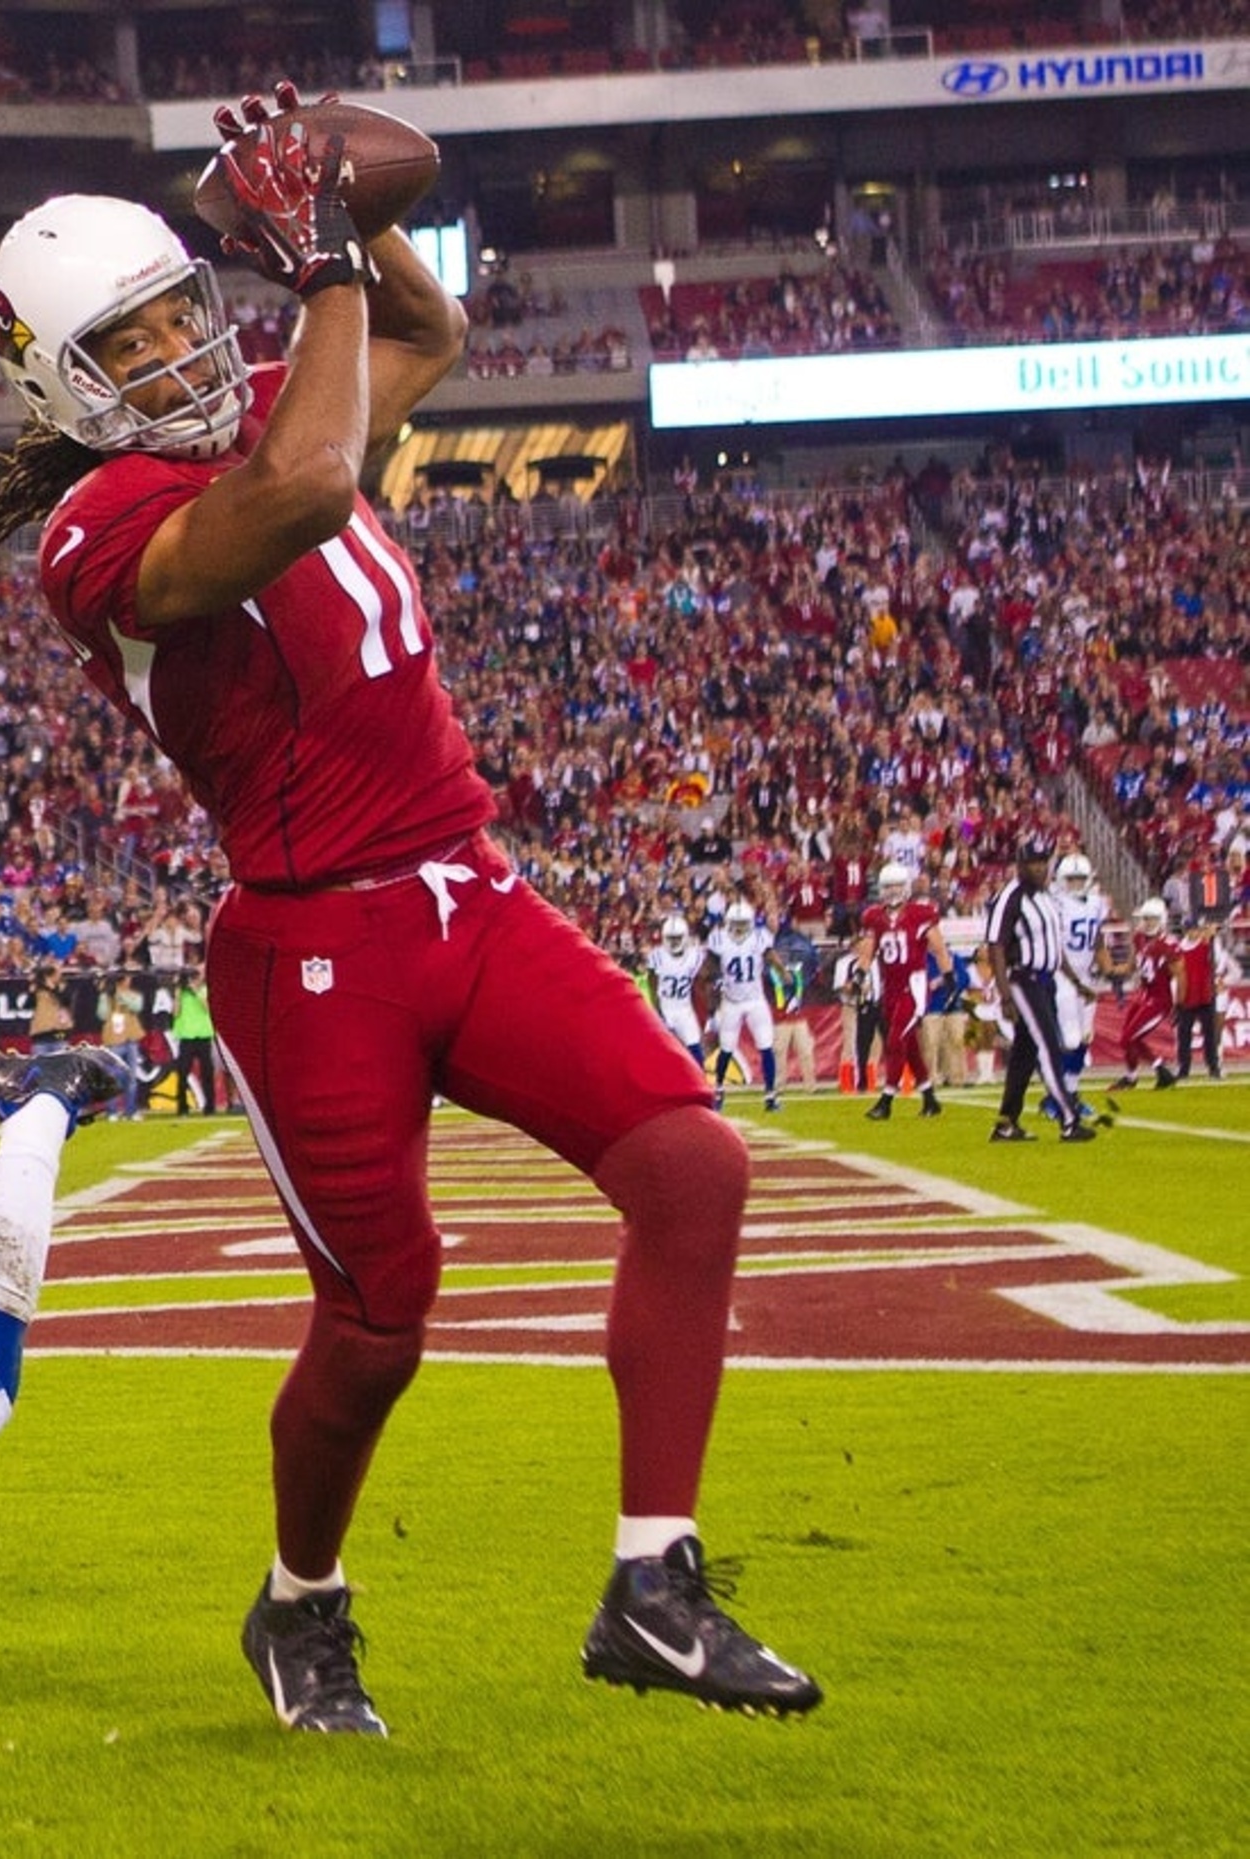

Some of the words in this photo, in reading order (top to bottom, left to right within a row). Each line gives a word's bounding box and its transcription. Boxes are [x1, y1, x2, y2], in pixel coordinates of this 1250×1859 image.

[1019, 53, 1204, 88] HYUNDAI
[1019, 356, 1100, 391] Dell
[1121, 348, 1250, 388] Sonic
[319, 511, 424, 679] 11
[727, 955, 755, 983] 41
[661, 975, 692, 999] 32
